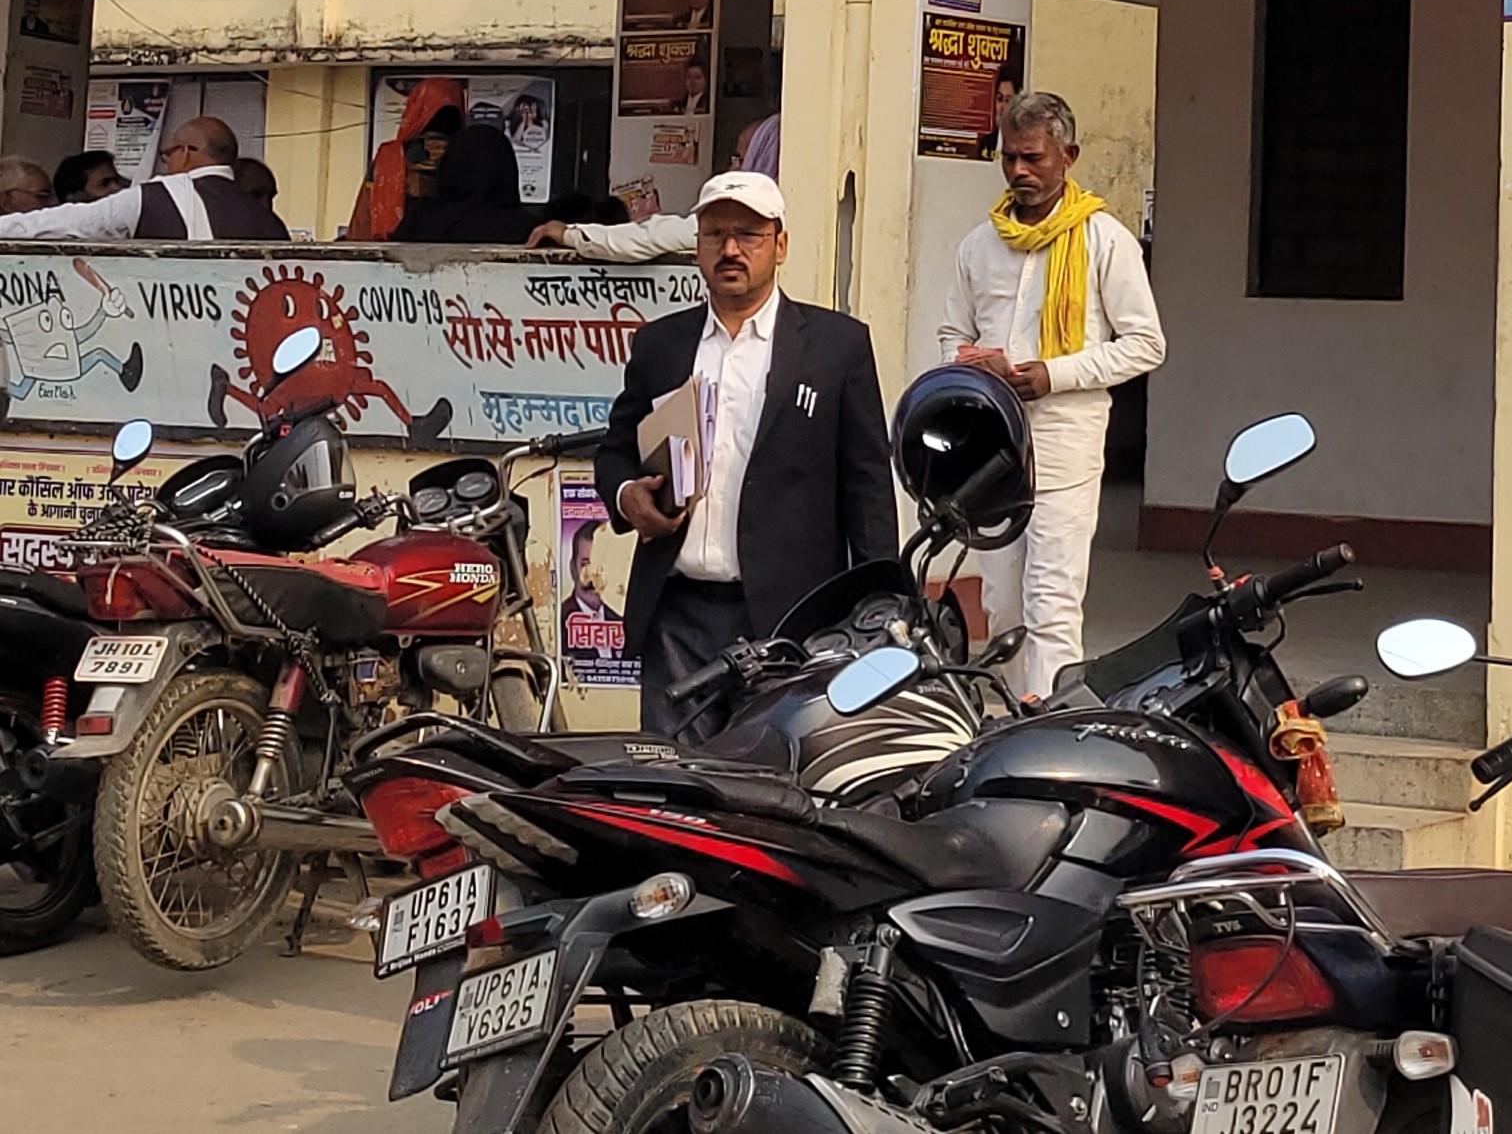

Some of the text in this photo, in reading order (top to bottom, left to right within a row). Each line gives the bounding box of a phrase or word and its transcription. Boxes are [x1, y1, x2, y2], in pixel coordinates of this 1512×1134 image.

[929, 28, 1009, 69] श्रद्धा शुक्ला
[138, 282, 222, 321] VIRUS
[359, 286, 444, 325] COVID-19
[525, 276, 580, 307] स्वच्छ
[522, 319, 585, 370] नगर
[66, 477, 94, 501] ऑफ
[28, 499, 37, 516] के
[449, 572, 497, 584] HONDA
[453, 562, 494, 574] HERO
[89, 661, 144, 675] 7891
[410, 871, 478, 921] UP61A
[1213, 919, 1242, 933] TVS
[473, 957, 542, 1009] UP61A
[1223, 1060, 1326, 1104] BR01F
